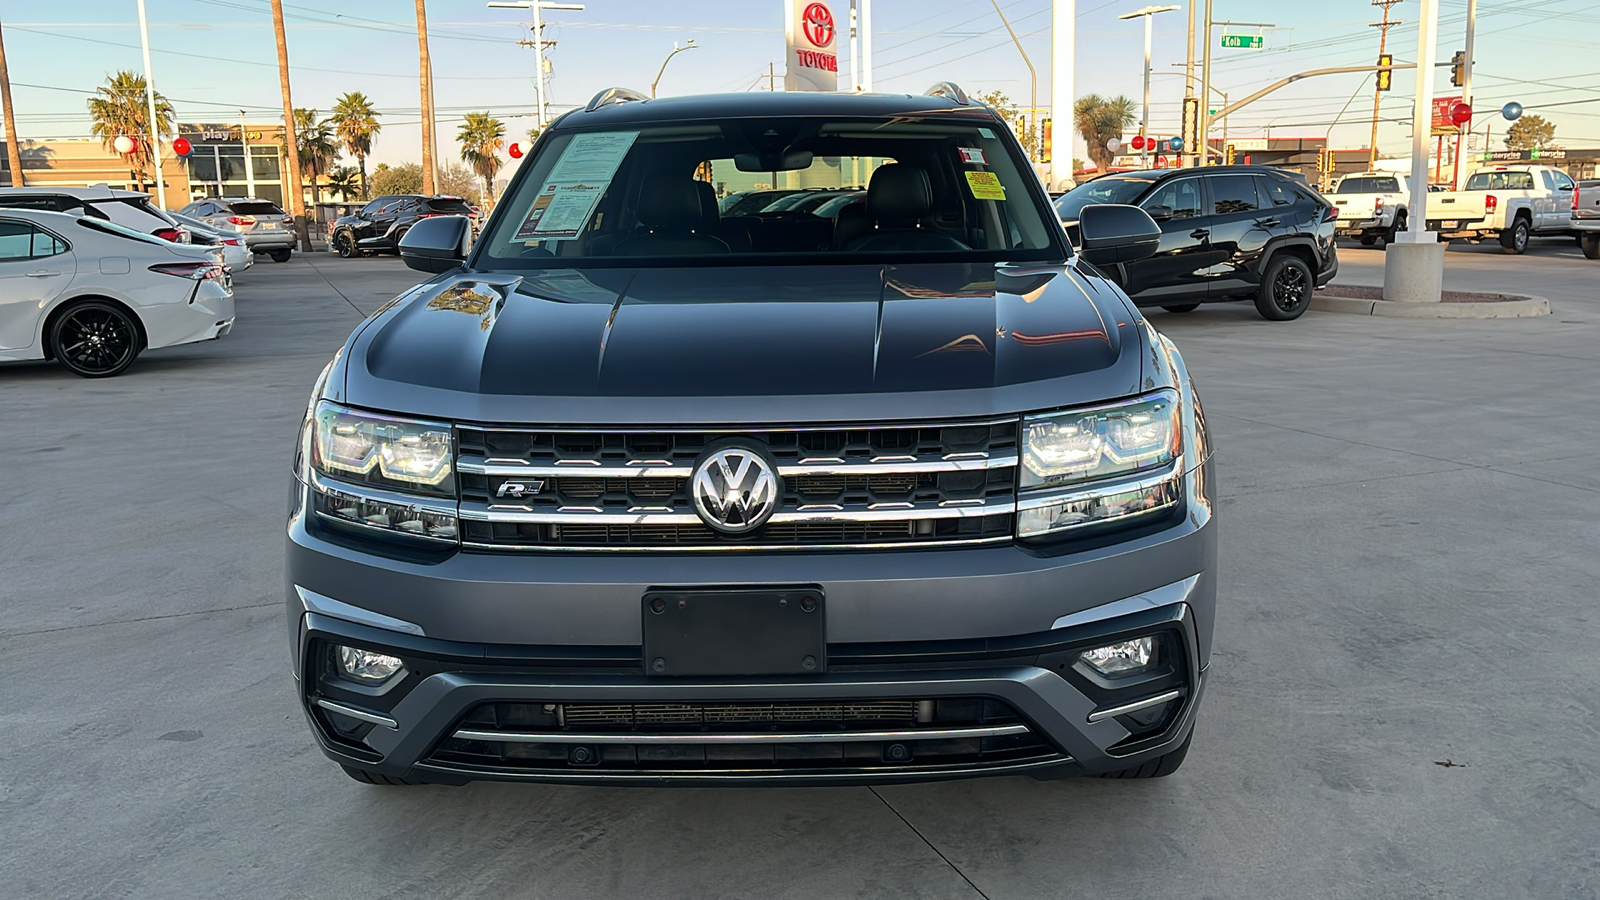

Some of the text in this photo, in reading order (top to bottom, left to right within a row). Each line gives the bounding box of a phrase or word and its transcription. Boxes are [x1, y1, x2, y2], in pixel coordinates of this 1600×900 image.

[1226, 36, 1241, 47] Kolb
[796, 49, 838, 72] TOYOTA
[1486, 151, 1521, 159] enterprise
[1534, 150, 1566, 158] enterprise
